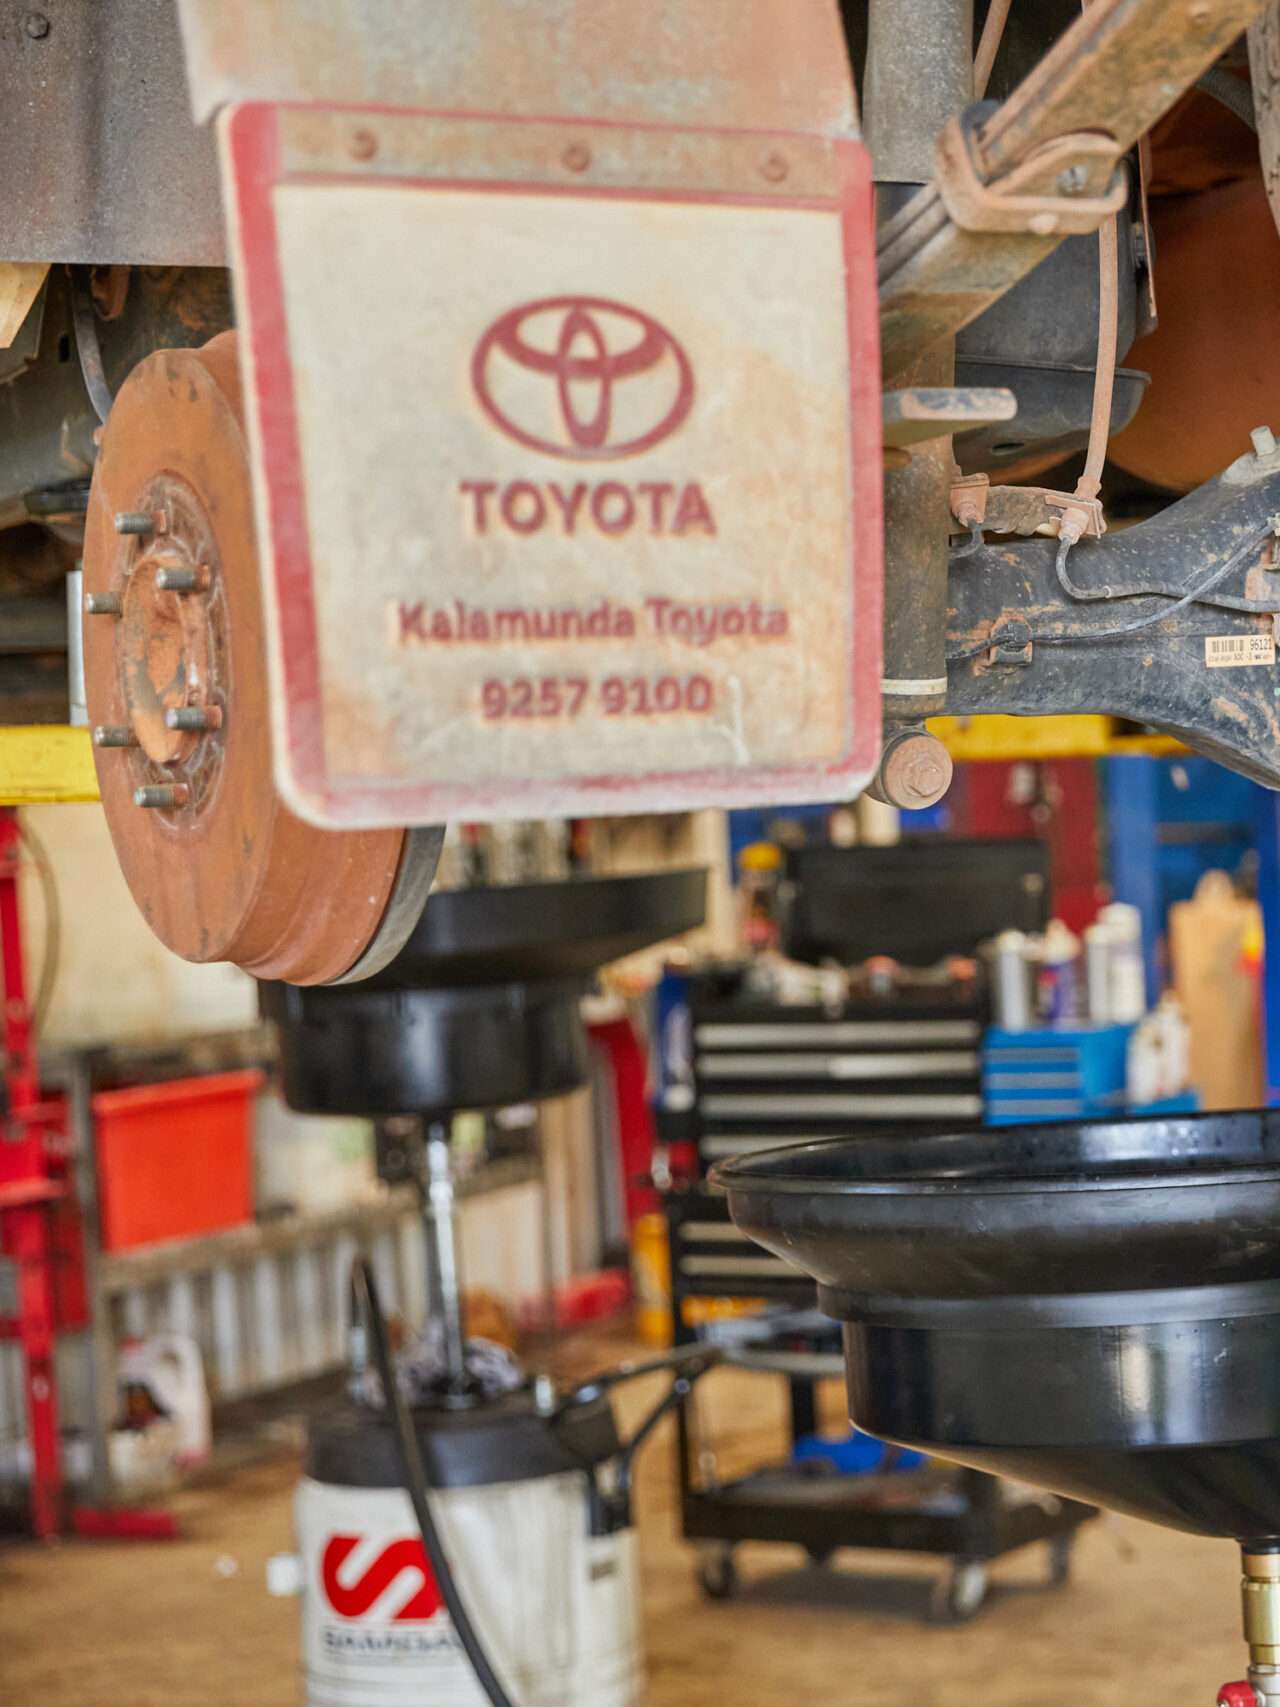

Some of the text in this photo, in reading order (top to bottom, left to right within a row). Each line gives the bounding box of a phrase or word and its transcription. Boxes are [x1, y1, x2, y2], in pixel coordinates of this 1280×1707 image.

[459, 480, 717, 536] TOYOTA
[398, 599, 789, 648] Kalamunda Toyota
[481, 672, 714, 719] 9257 9100
